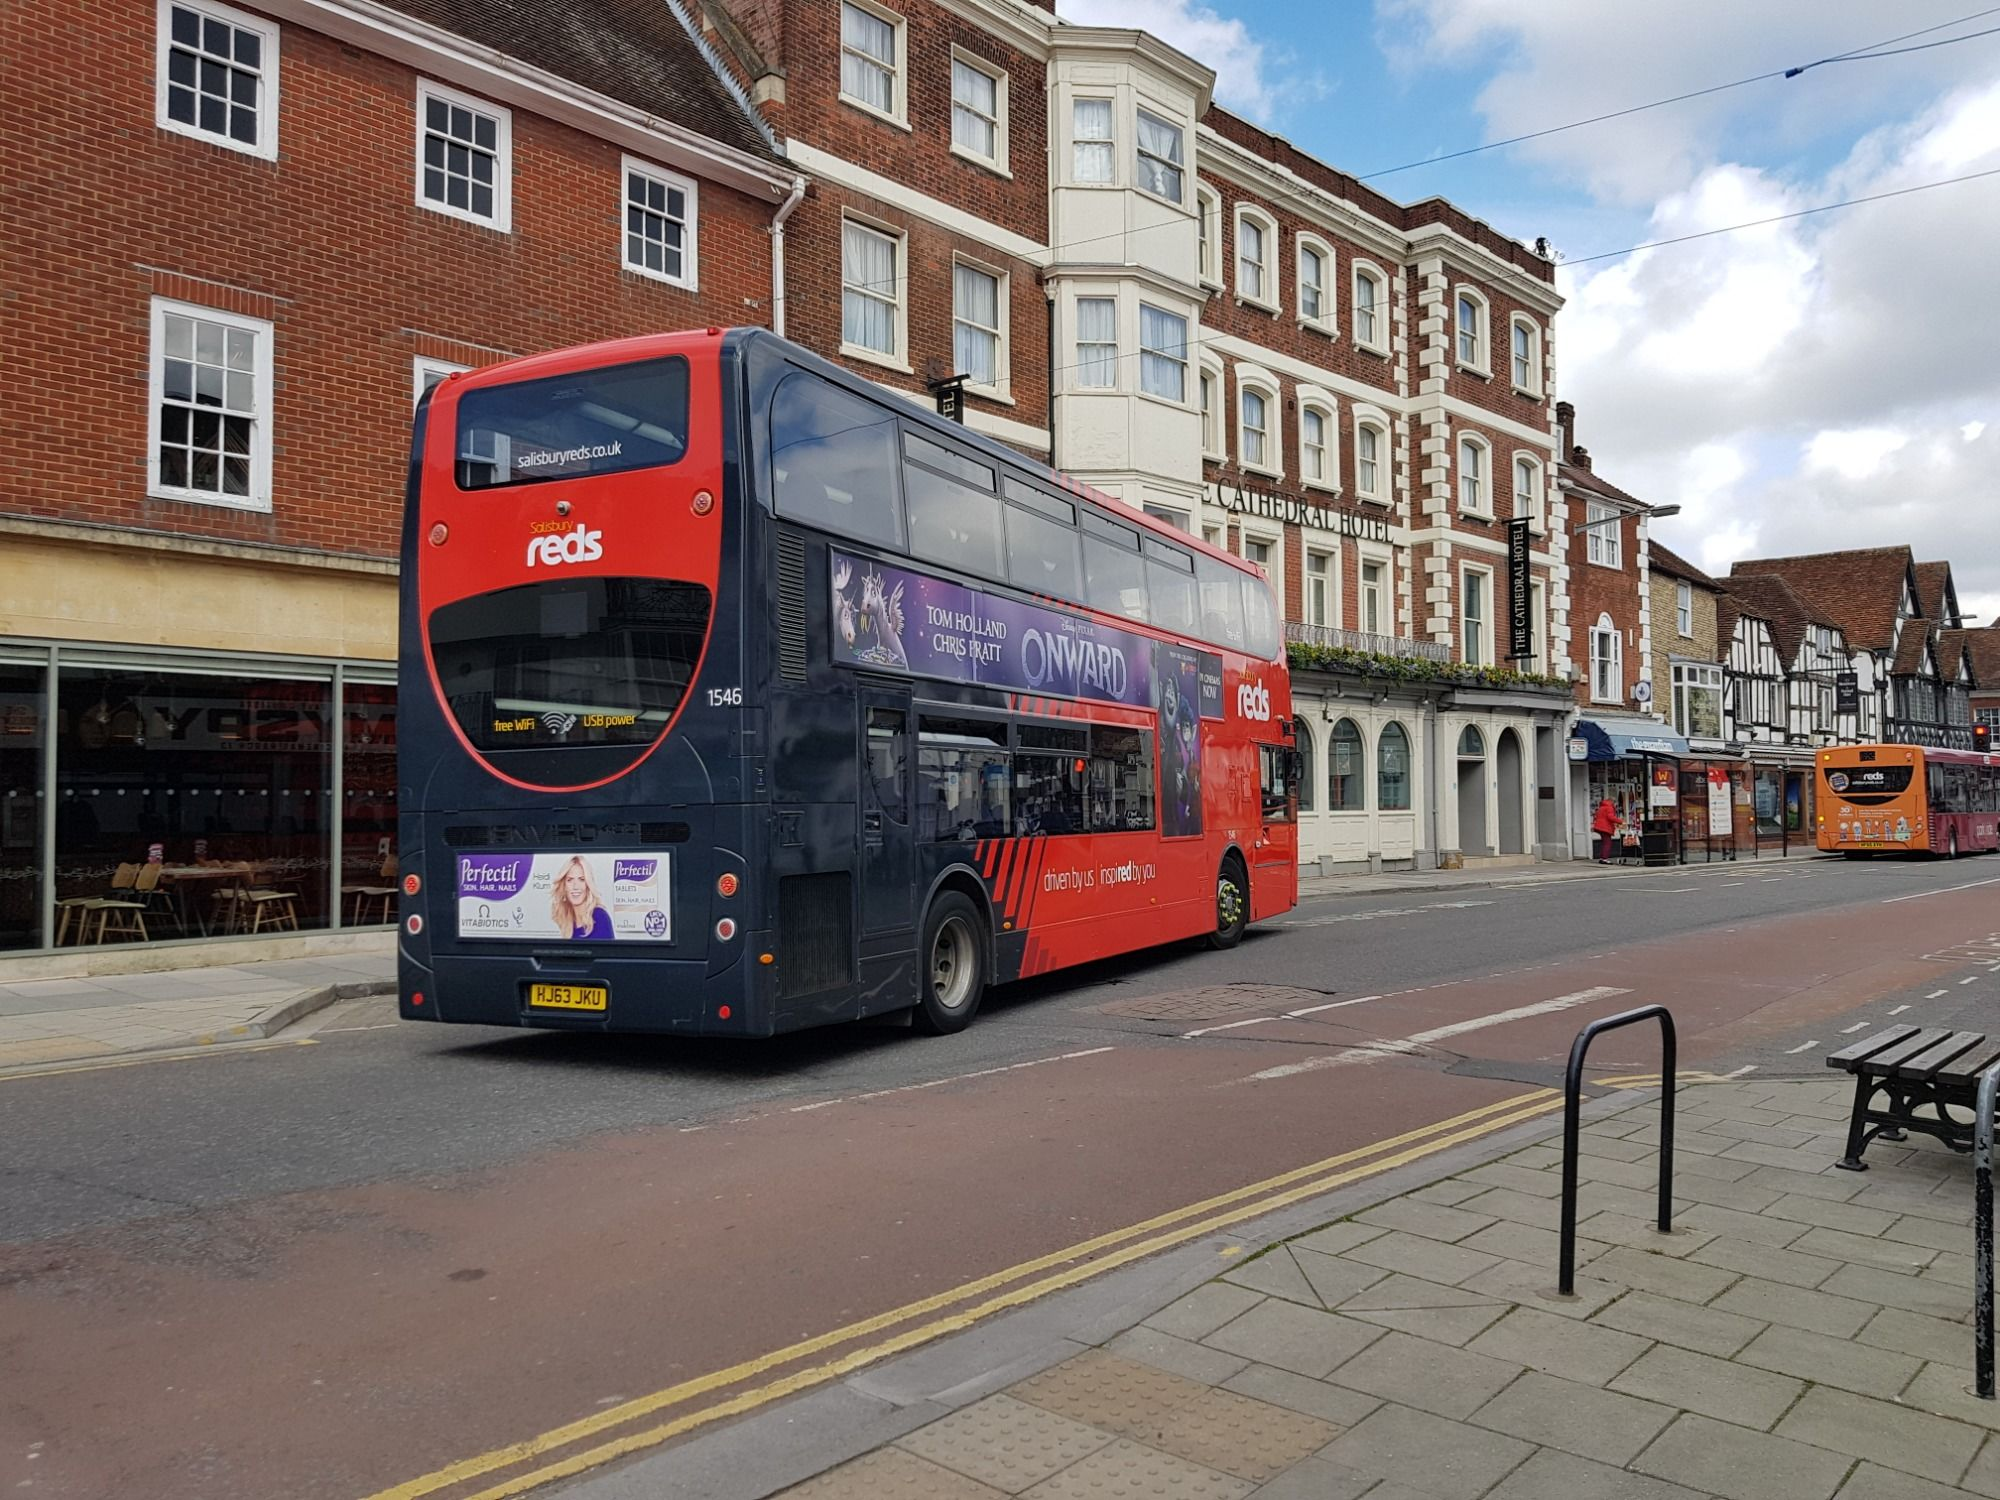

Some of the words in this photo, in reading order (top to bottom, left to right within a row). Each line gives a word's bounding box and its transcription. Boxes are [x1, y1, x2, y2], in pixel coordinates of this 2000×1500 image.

[518, 440, 622, 468] salisburyreds.co.uk
[1217, 477, 1335, 531] CATHEDRAL
[1339, 506, 1395, 543] HOTEL
[530, 520, 574, 535] Salisbury
[527, 523, 603, 567] reds
[1513, 526, 1524, 562] HOTEL
[1514, 563, 1526, 627] CATHEDRAL
[926, 605, 953, 629] TOM
[955, 612, 1007, 639] HOLLAND
[933, 633, 967, 661] CHRIS
[969, 639, 1002, 665] PRATT
[1515, 628, 1526, 650] THE
[1021, 628, 1127, 700] ONWARD
[708, 688, 742, 706] 1546
[1203, 685, 1217, 699] NOW
[1237, 678, 1270, 721] reds
[494, 719, 513, 732] free
[515, 718, 535, 731] WiFi
[583, 714, 603, 727] USB
[605, 714, 635, 728] power
[1863, 771, 1884, 780] reds
[461, 858, 520, 884] Perfectil
[615, 862, 655, 878] Perfectil
[1044, 867, 1072, 892] driven
[1072, 865, 1083, 893] by
[1084, 869, 1094, 887] us
[1100, 860, 1132, 888] inspired
[1132, 860, 1141, 885] by
[1142, 863, 1156, 884] you
[498, 884, 517, 892] NAILS
[461, 919, 510, 928] VITABIOTICS
[536, 986, 571, 1005] HJ63
[574, 988, 601, 1006] JKU
